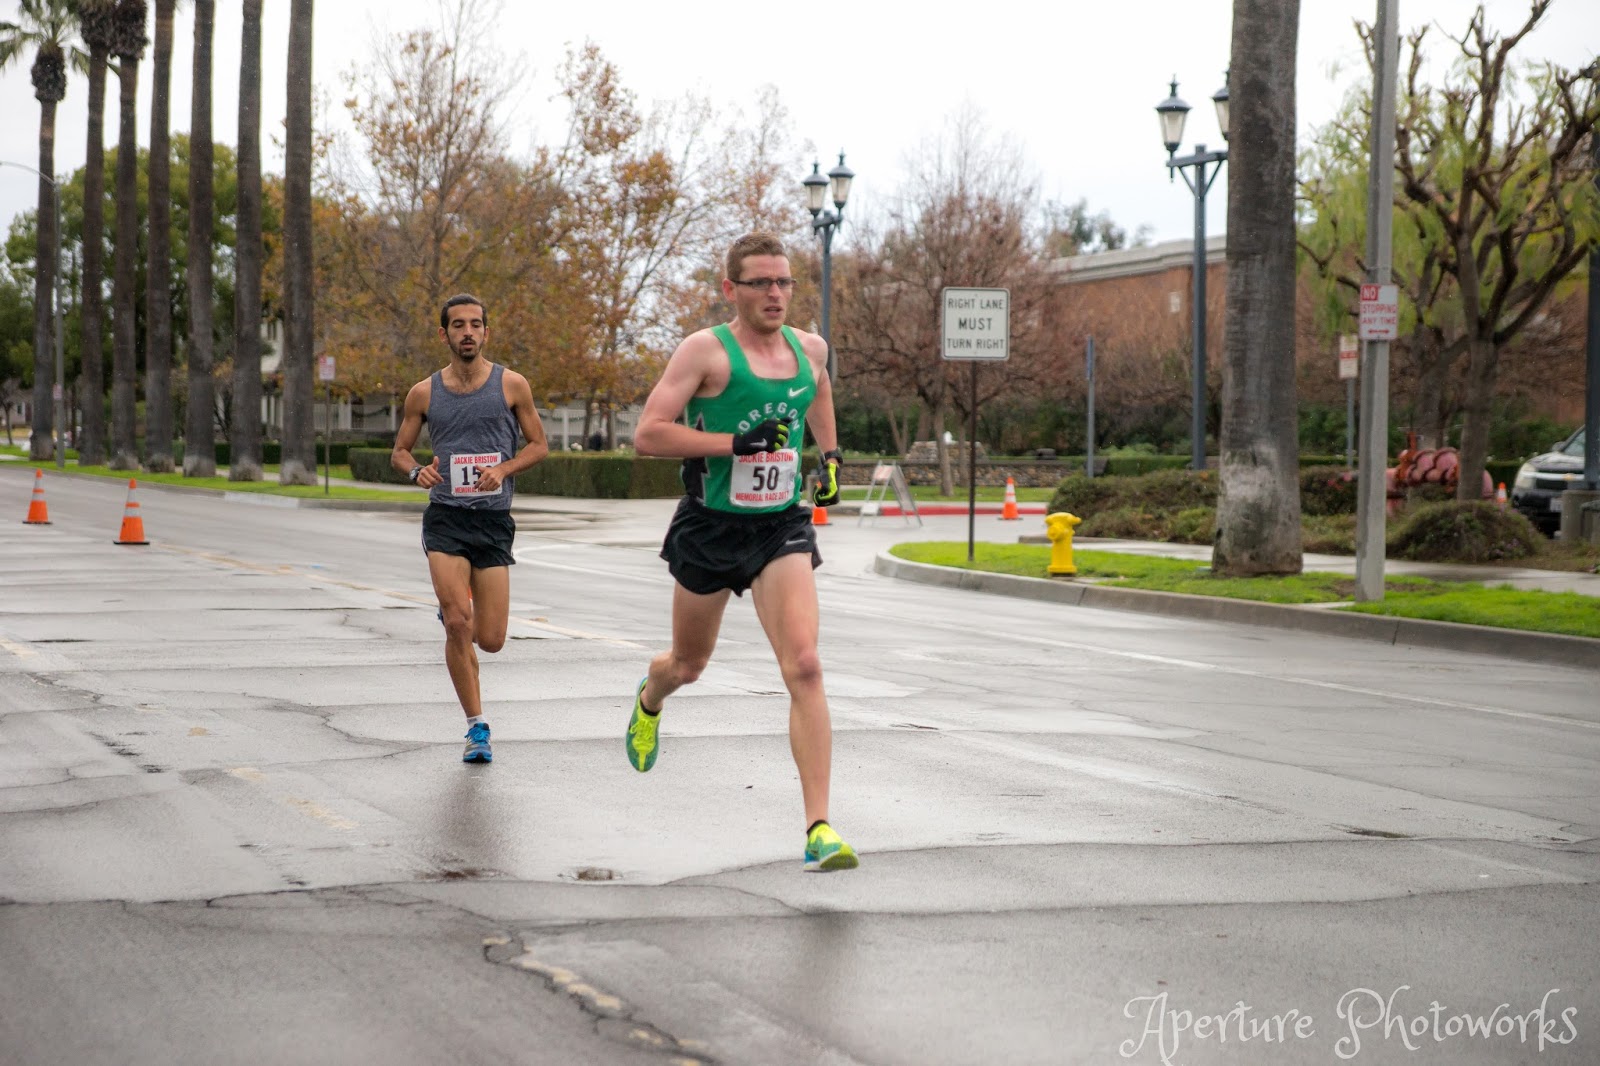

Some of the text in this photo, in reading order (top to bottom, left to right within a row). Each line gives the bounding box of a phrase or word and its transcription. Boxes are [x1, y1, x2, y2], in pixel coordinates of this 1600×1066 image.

[1363, 286, 1377, 300] NO
[948, 298, 1004, 310] RIGHT LANE
[1362, 304, 1396, 314] STOPPING
[958, 317, 993, 331] MUST
[1362, 316, 1397, 325] ANY TIME
[947, 337, 1004, 350] TURN RIGHT
[738, 402, 801, 432] OREGON
[454, 456, 498, 464] JACKIE BRISTOW
[738, 451, 794, 463] JACKIE BRISTOW
[752, 465, 780, 492] 50
[736, 492, 764, 502] MEMORIAL
[764, 492, 778, 501] RACE
